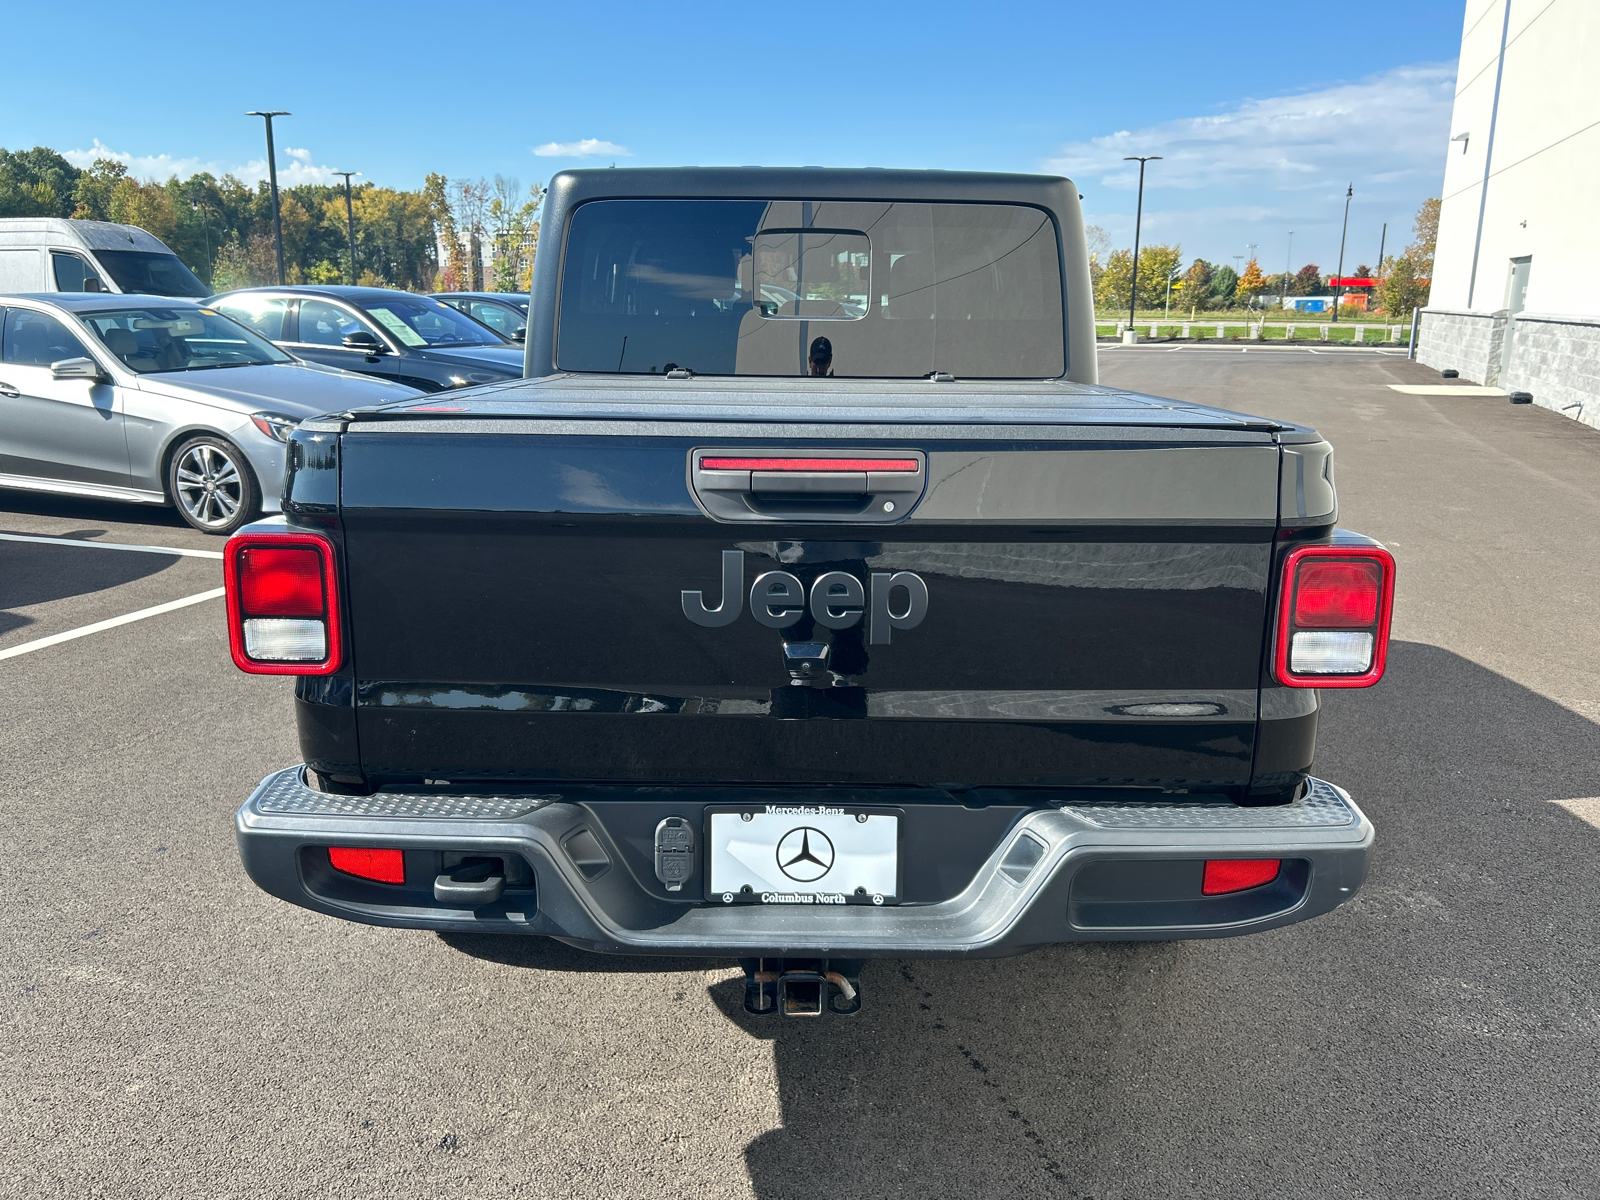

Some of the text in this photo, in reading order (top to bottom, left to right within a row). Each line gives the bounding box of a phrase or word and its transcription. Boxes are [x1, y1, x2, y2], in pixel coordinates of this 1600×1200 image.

[681, 549, 928, 646] Jeep
[765, 805, 845, 816] Mercedes-Benz
[761, 892, 847, 905] Columbus North
